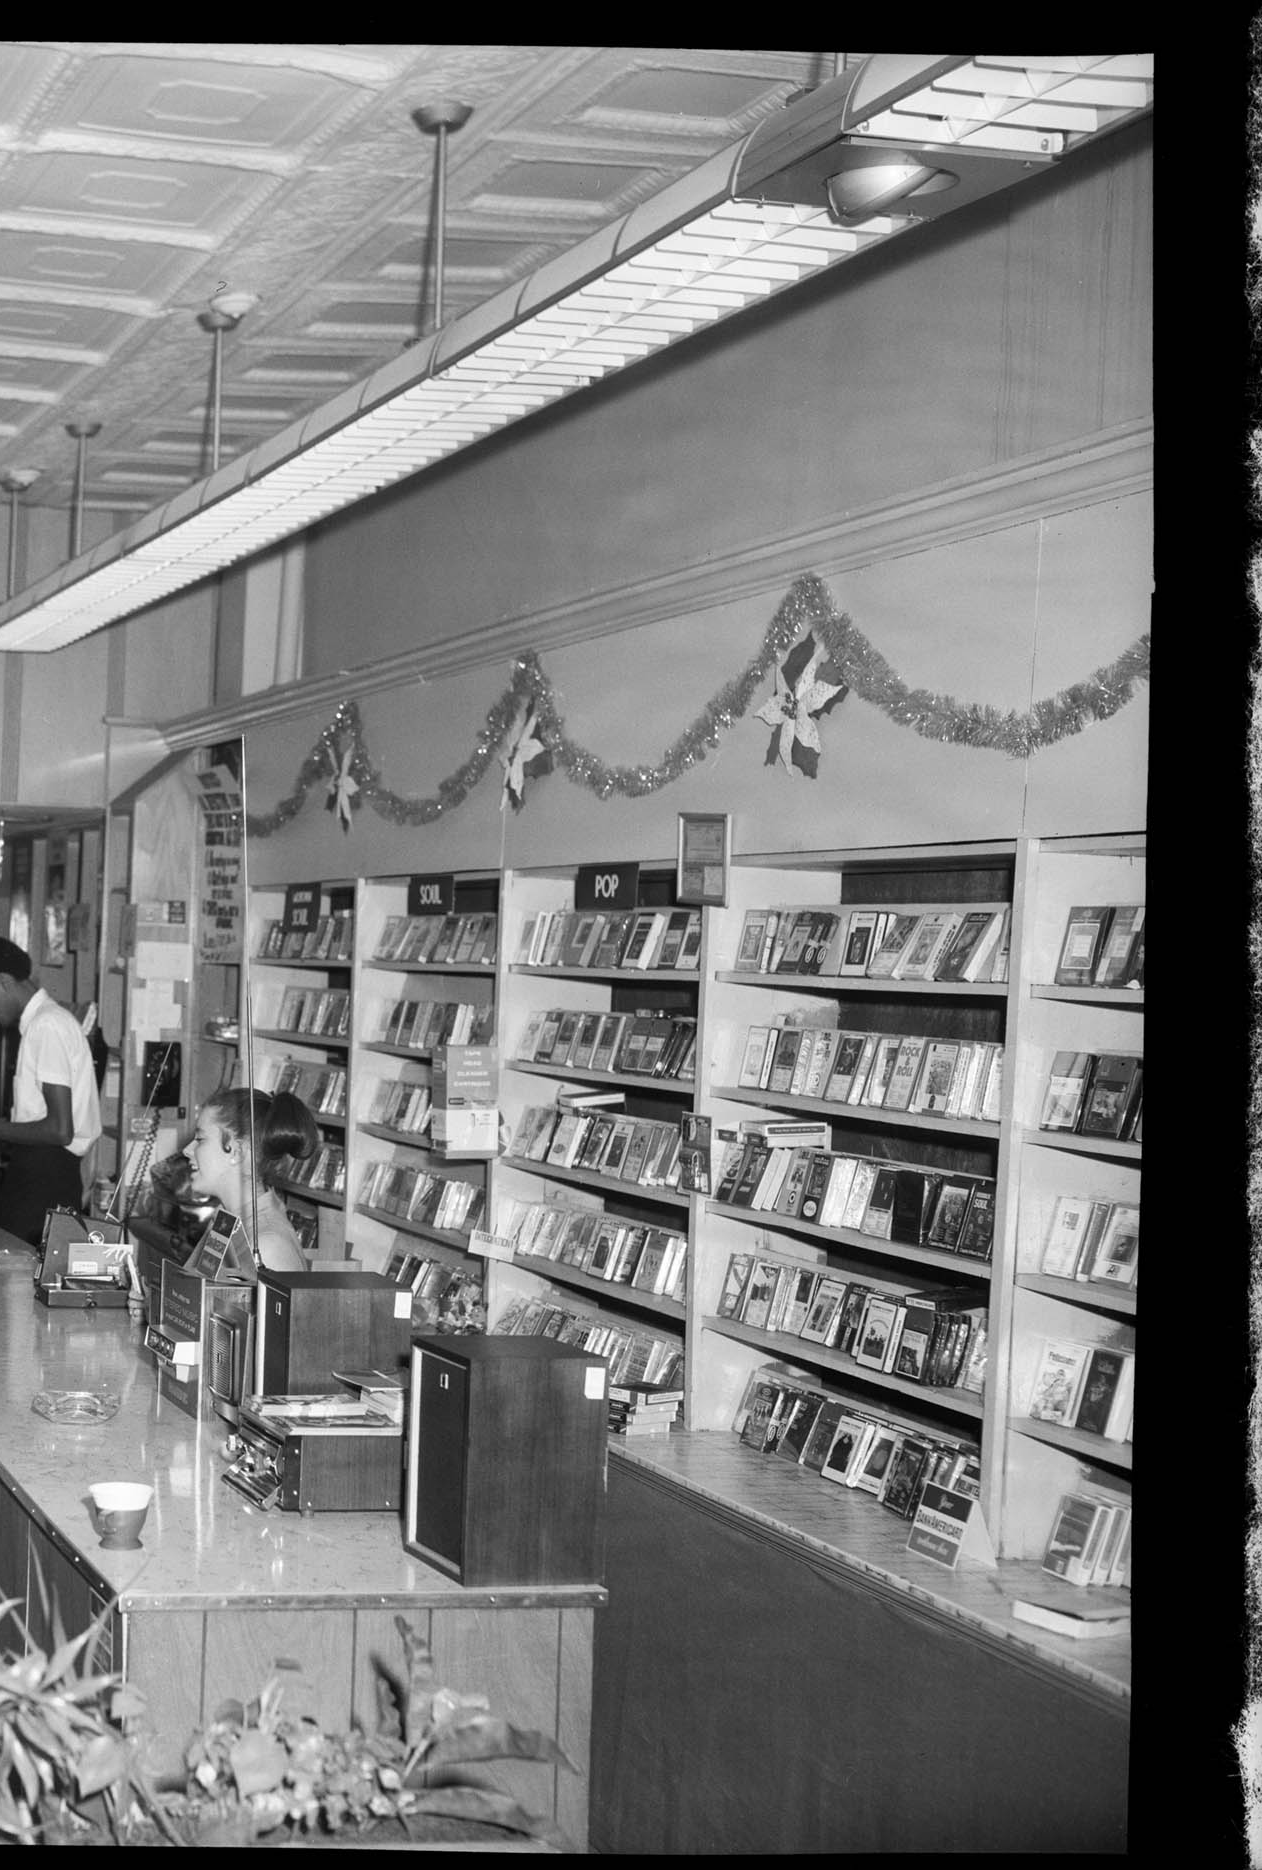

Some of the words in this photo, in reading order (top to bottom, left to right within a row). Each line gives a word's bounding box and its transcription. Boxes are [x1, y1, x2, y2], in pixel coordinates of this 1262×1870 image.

[419, 884, 442, 905] SOUL
[595, 874, 618, 898] POP
[900, 1046, 922, 1057] ROCK
